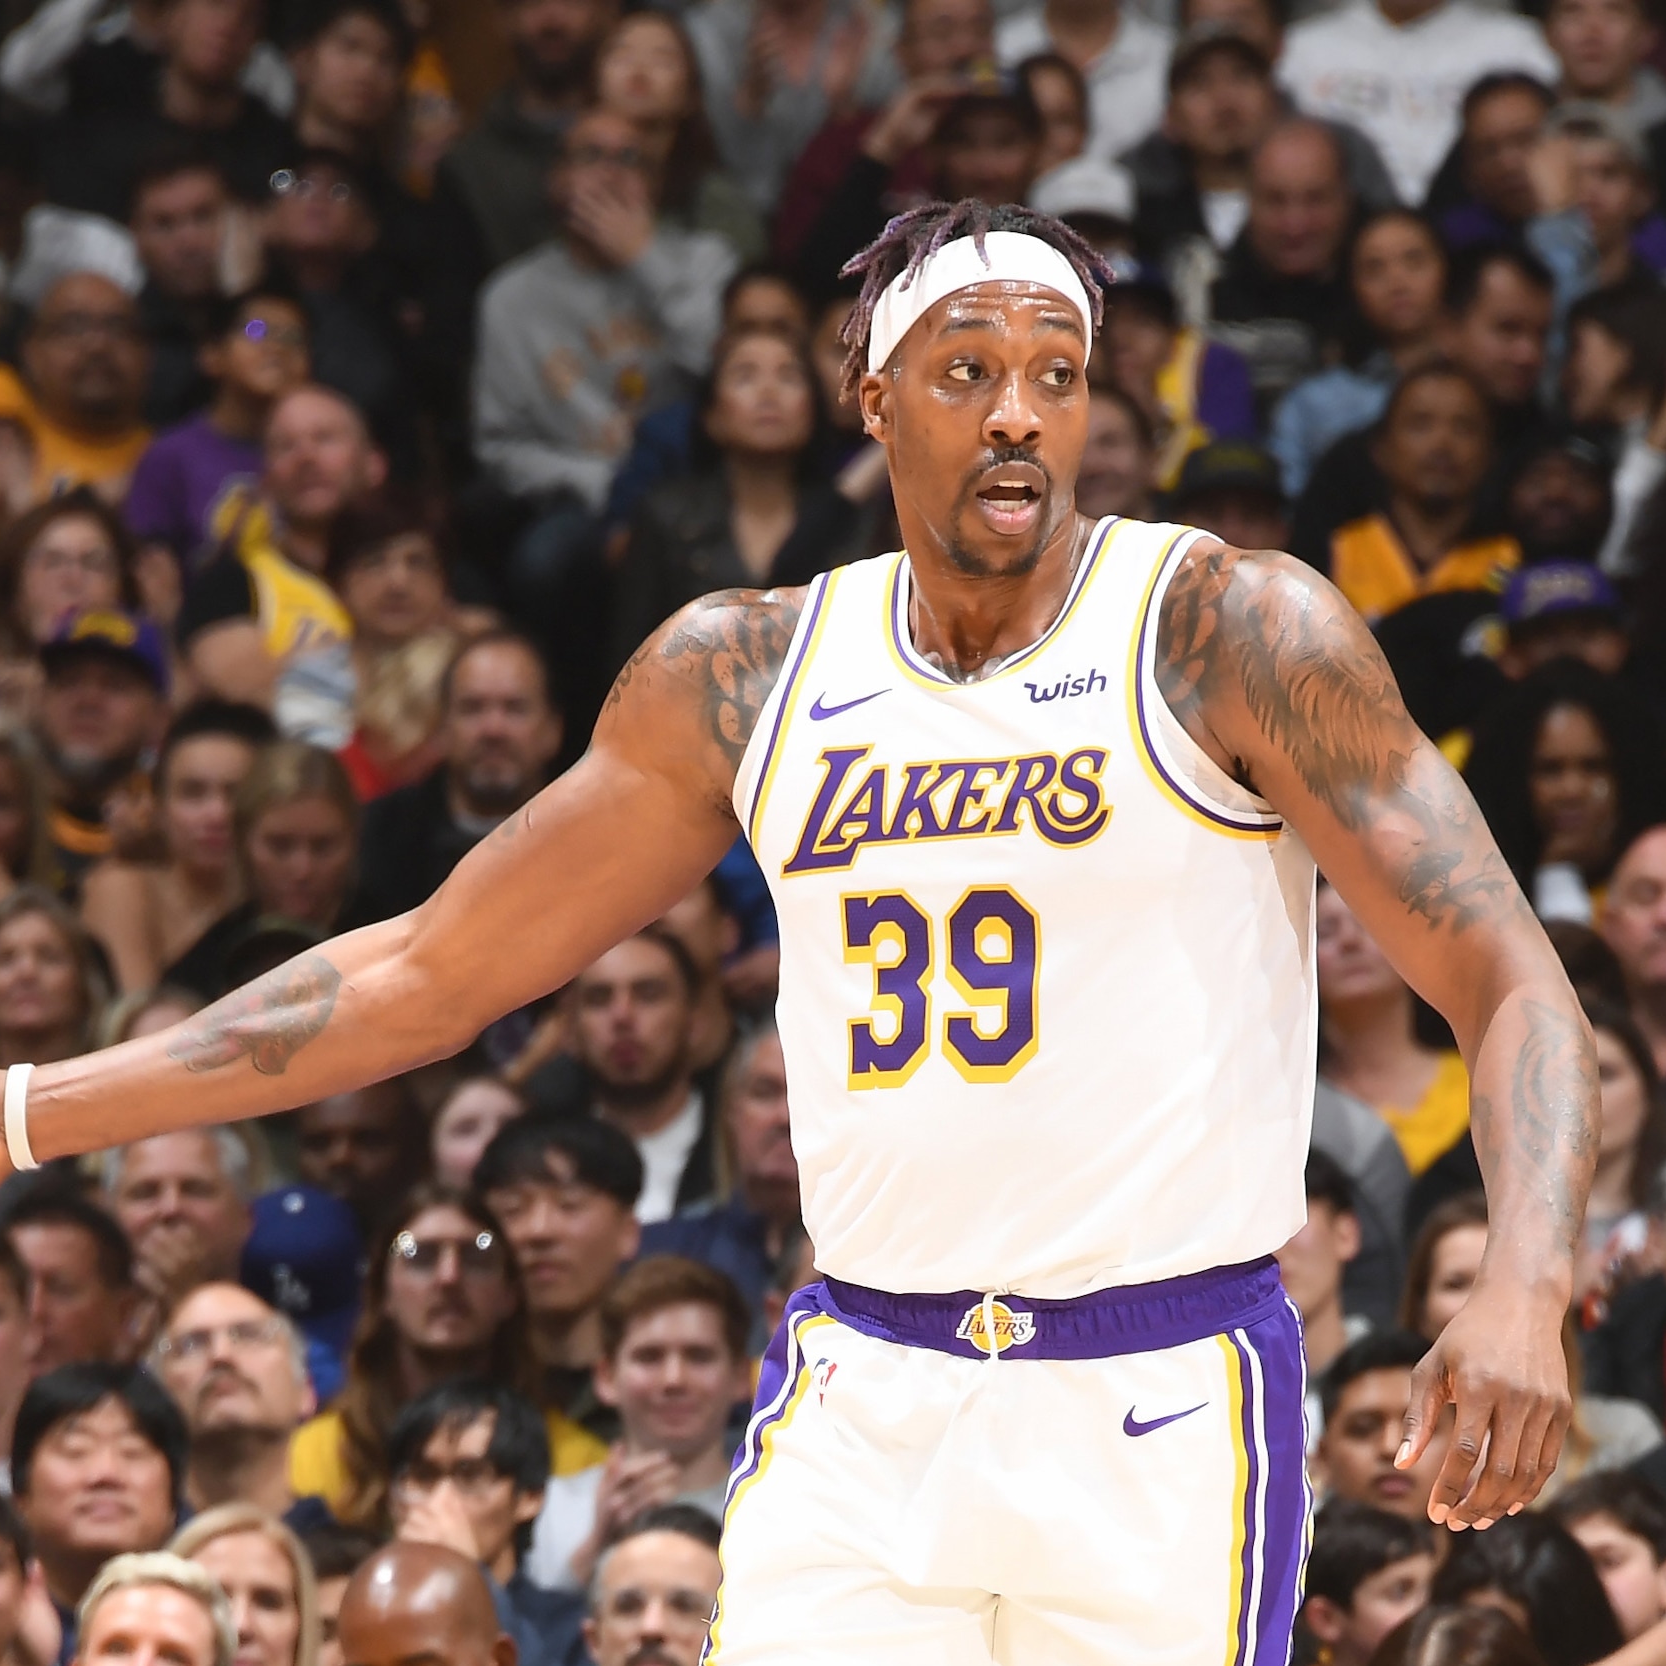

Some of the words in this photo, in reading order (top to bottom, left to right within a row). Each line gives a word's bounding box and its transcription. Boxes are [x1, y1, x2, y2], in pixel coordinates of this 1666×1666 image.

[1023, 667, 1107, 703] wish
[780, 743, 1114, 878] LAKERS
[839, 884, 1042, 1091] 39
[958, 1313, 1033, 1341] LAERS
